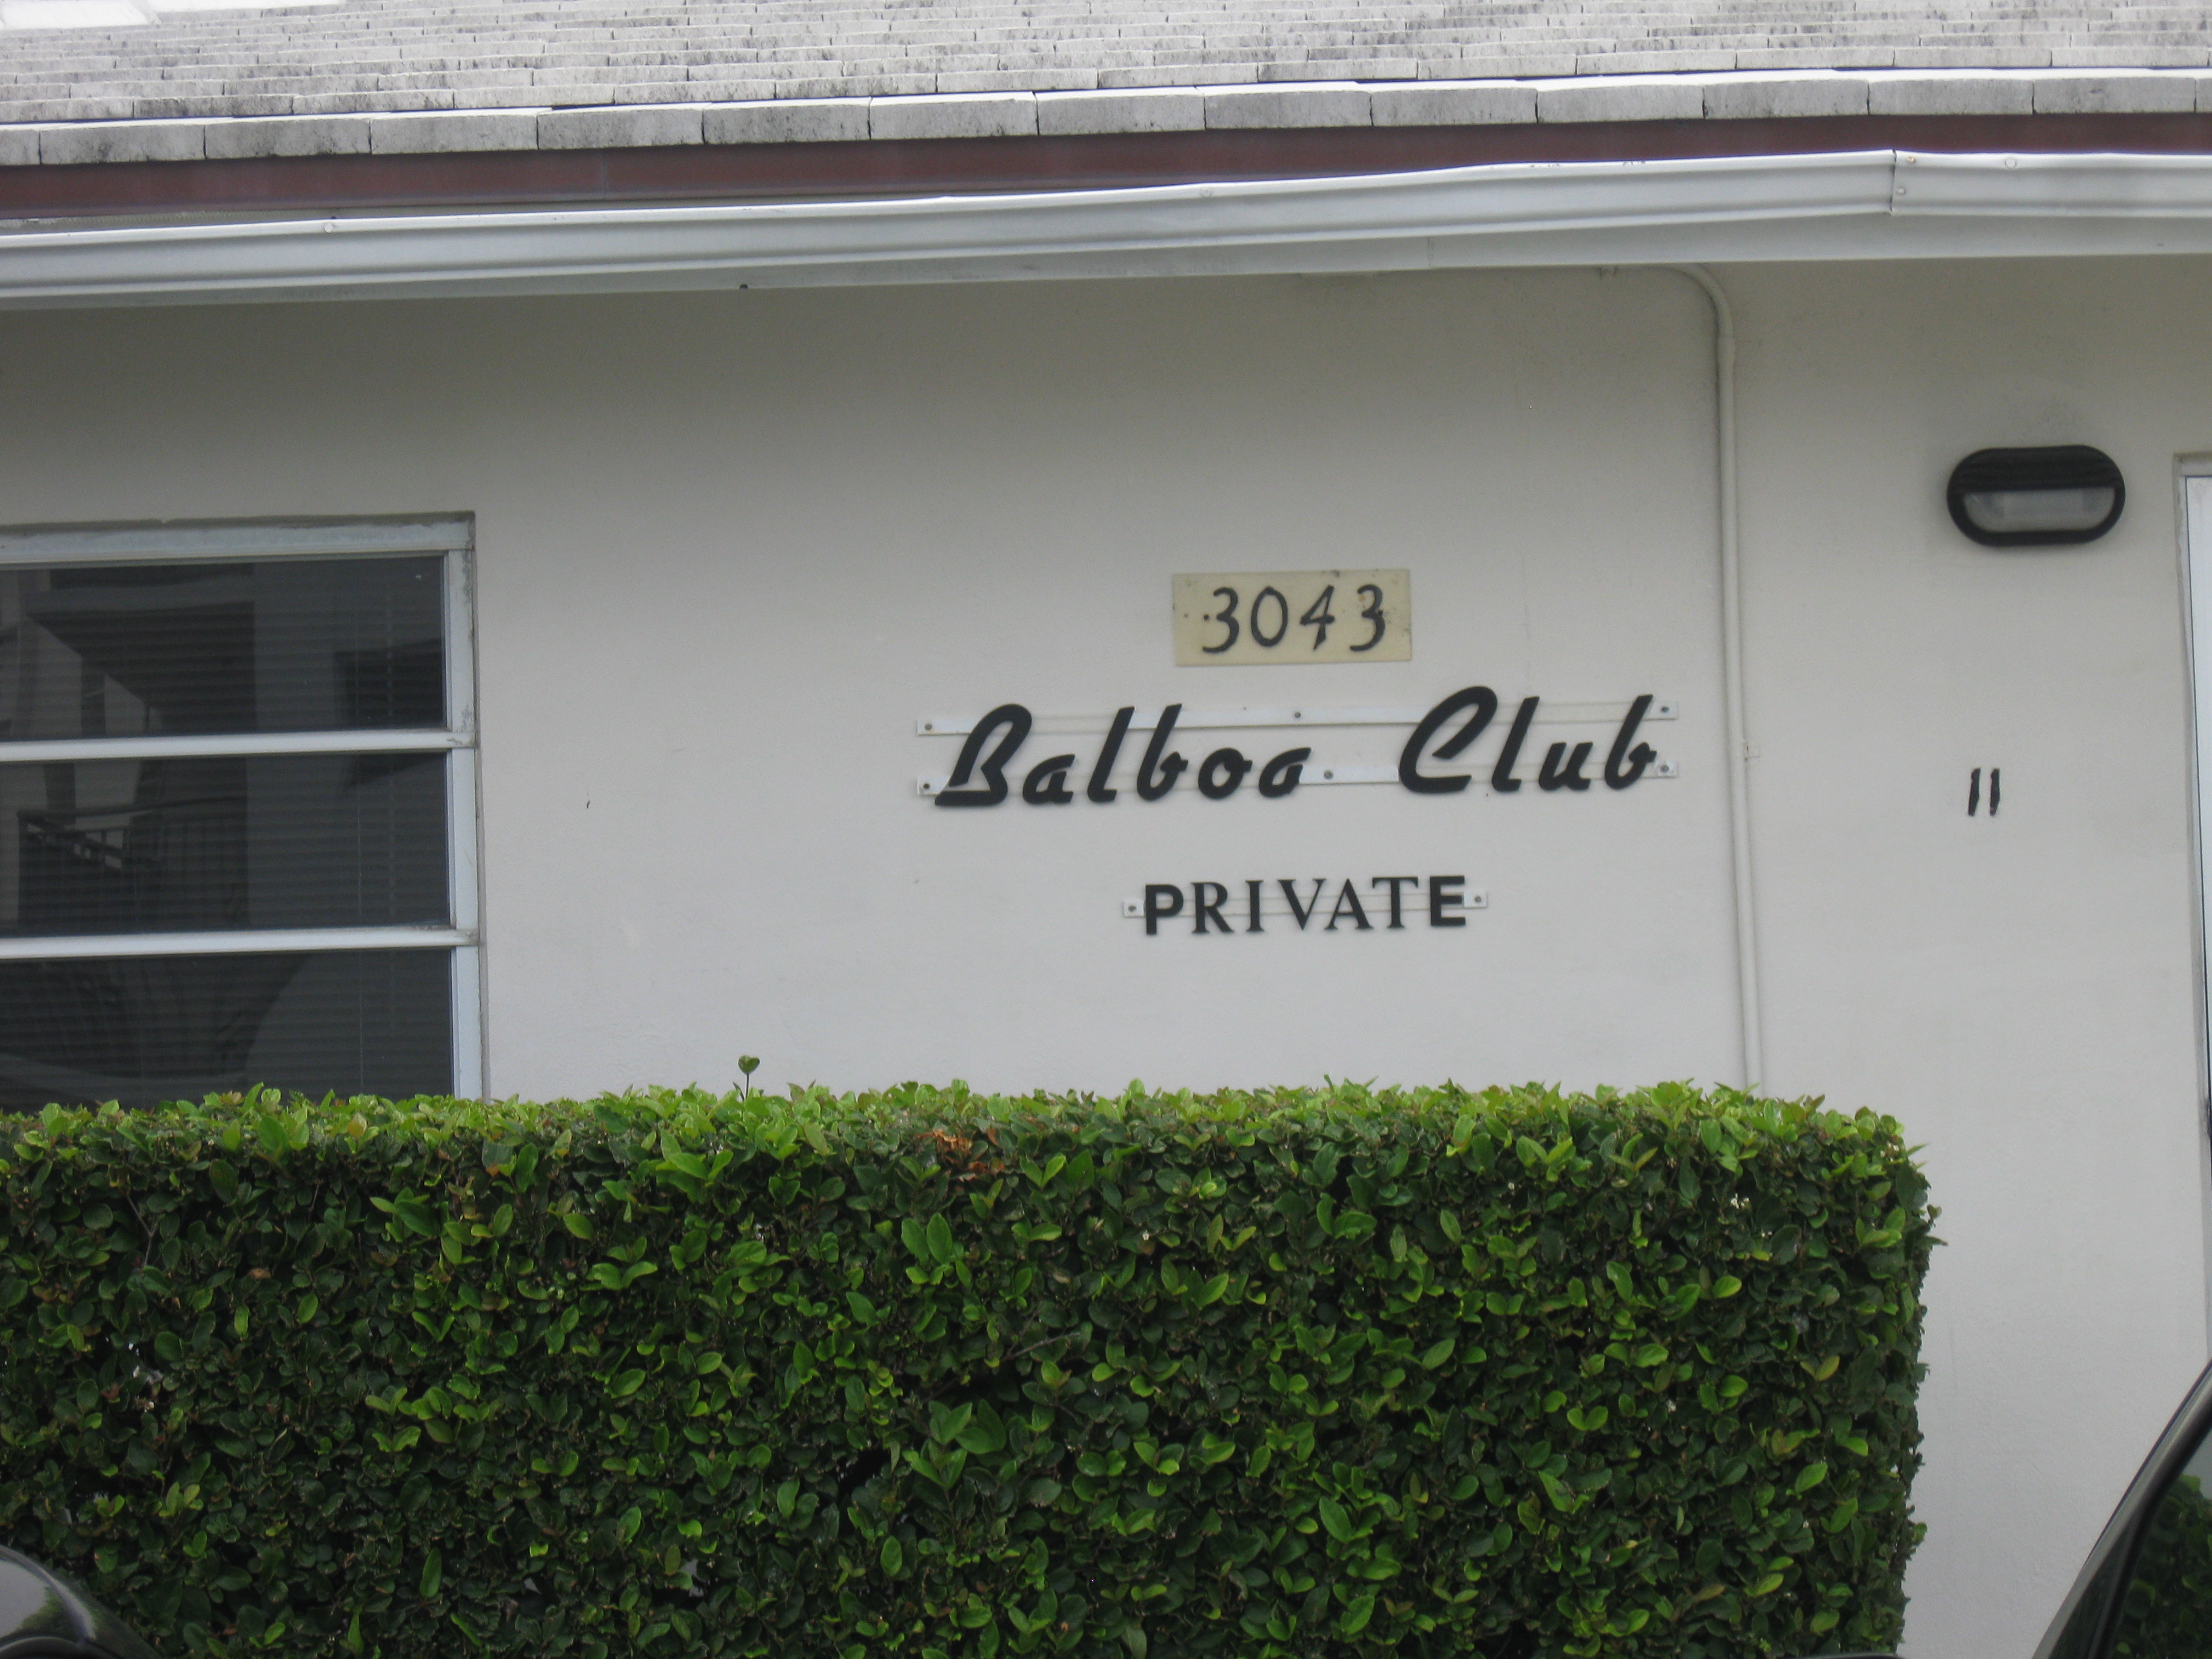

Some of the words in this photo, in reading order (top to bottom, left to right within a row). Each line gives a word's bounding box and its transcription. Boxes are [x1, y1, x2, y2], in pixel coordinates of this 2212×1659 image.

[1202, 584, 1386, 654] 3043
[934, 703, 1312, 808] Balboa
[1398, 685, 1657, 795] Club
[1967, 768, 2001, 817] 11
[1144, 875, 1466, 936] PRIVATE
